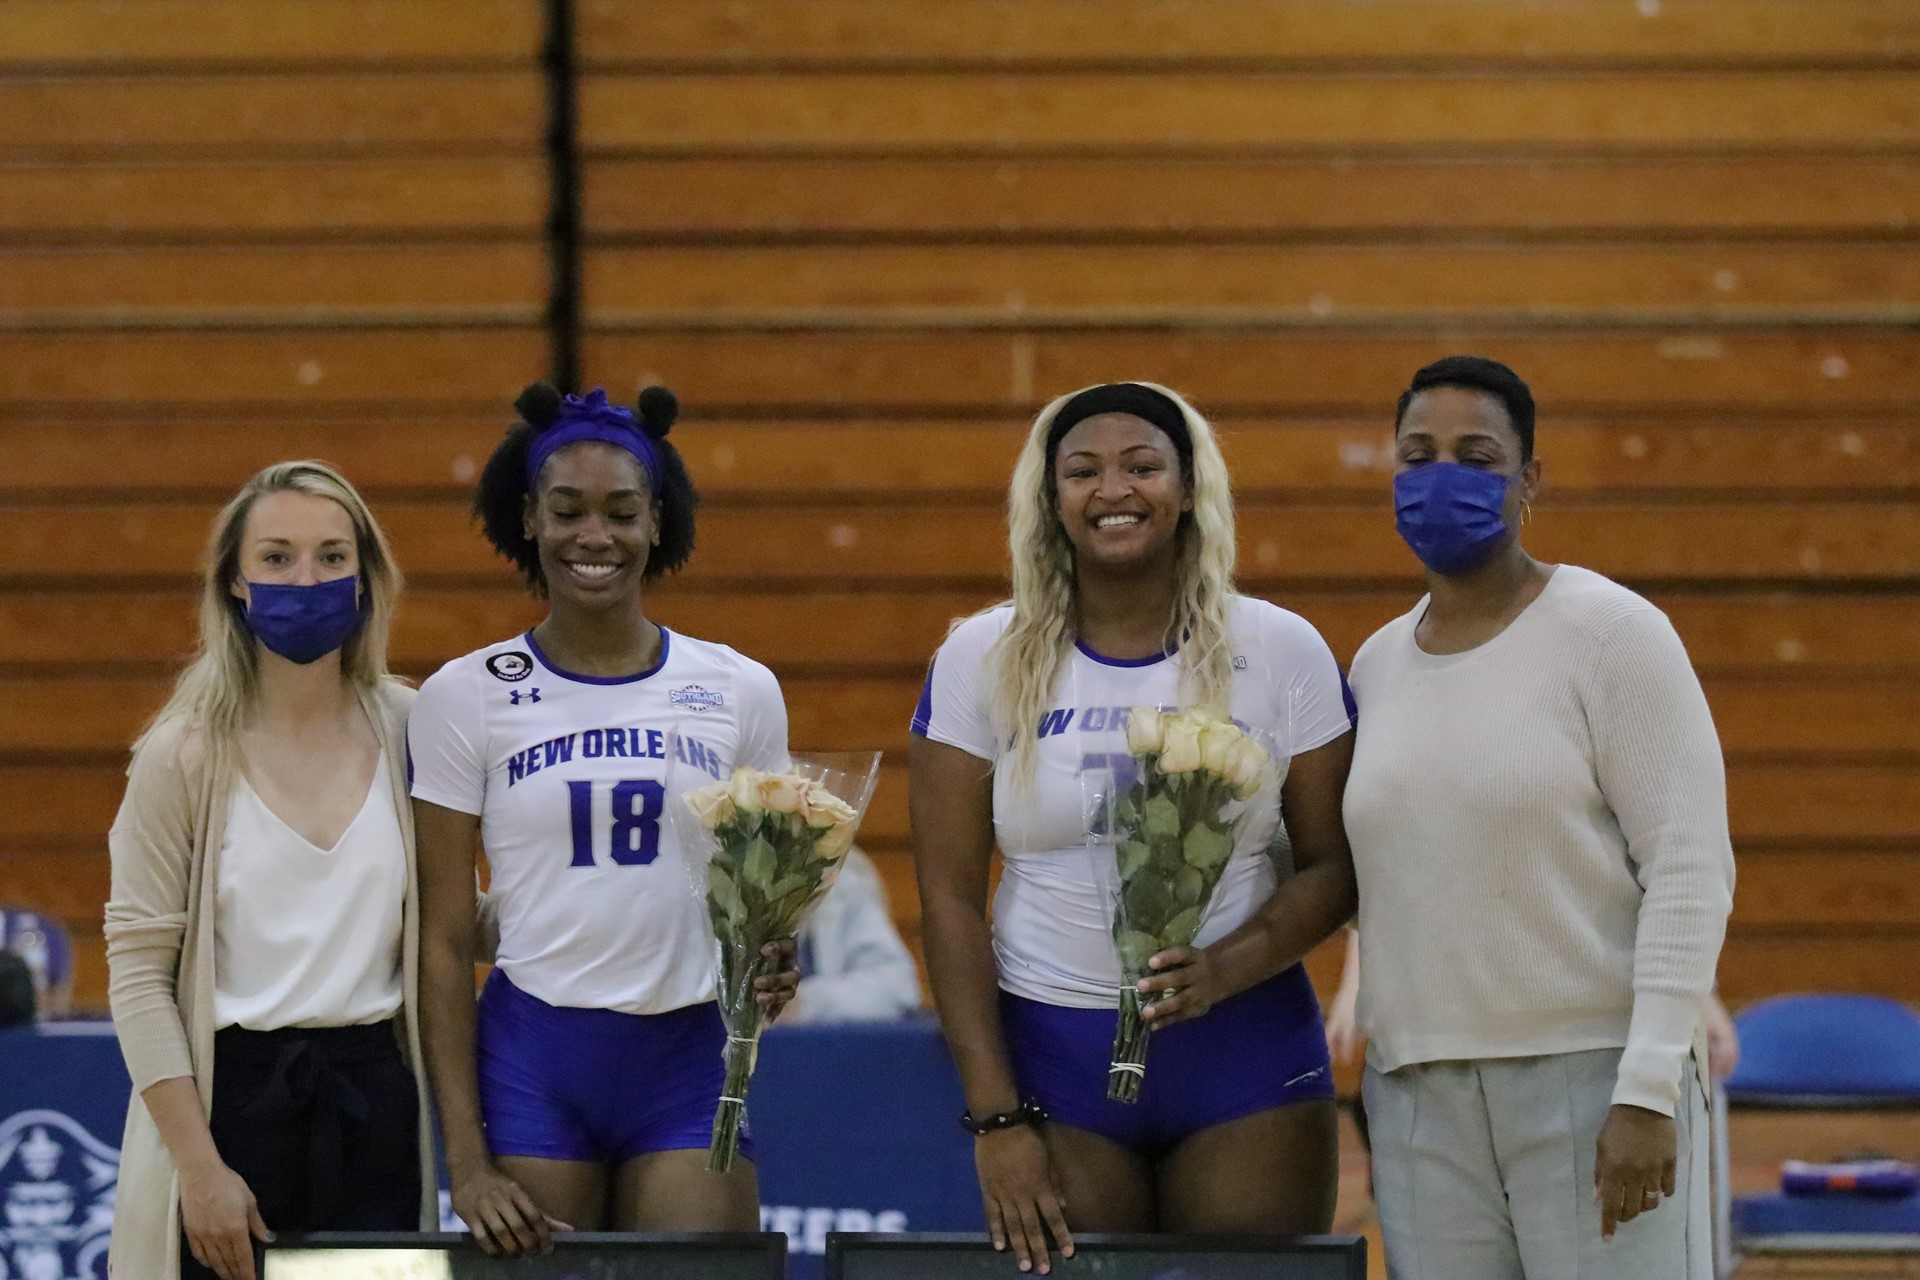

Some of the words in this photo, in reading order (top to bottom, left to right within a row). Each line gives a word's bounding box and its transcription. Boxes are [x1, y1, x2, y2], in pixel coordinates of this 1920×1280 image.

[508, 732, 577, 789] NEW
[582, 728, 720, 781] ORLEANS
[566, 779, 665, 866] 18
